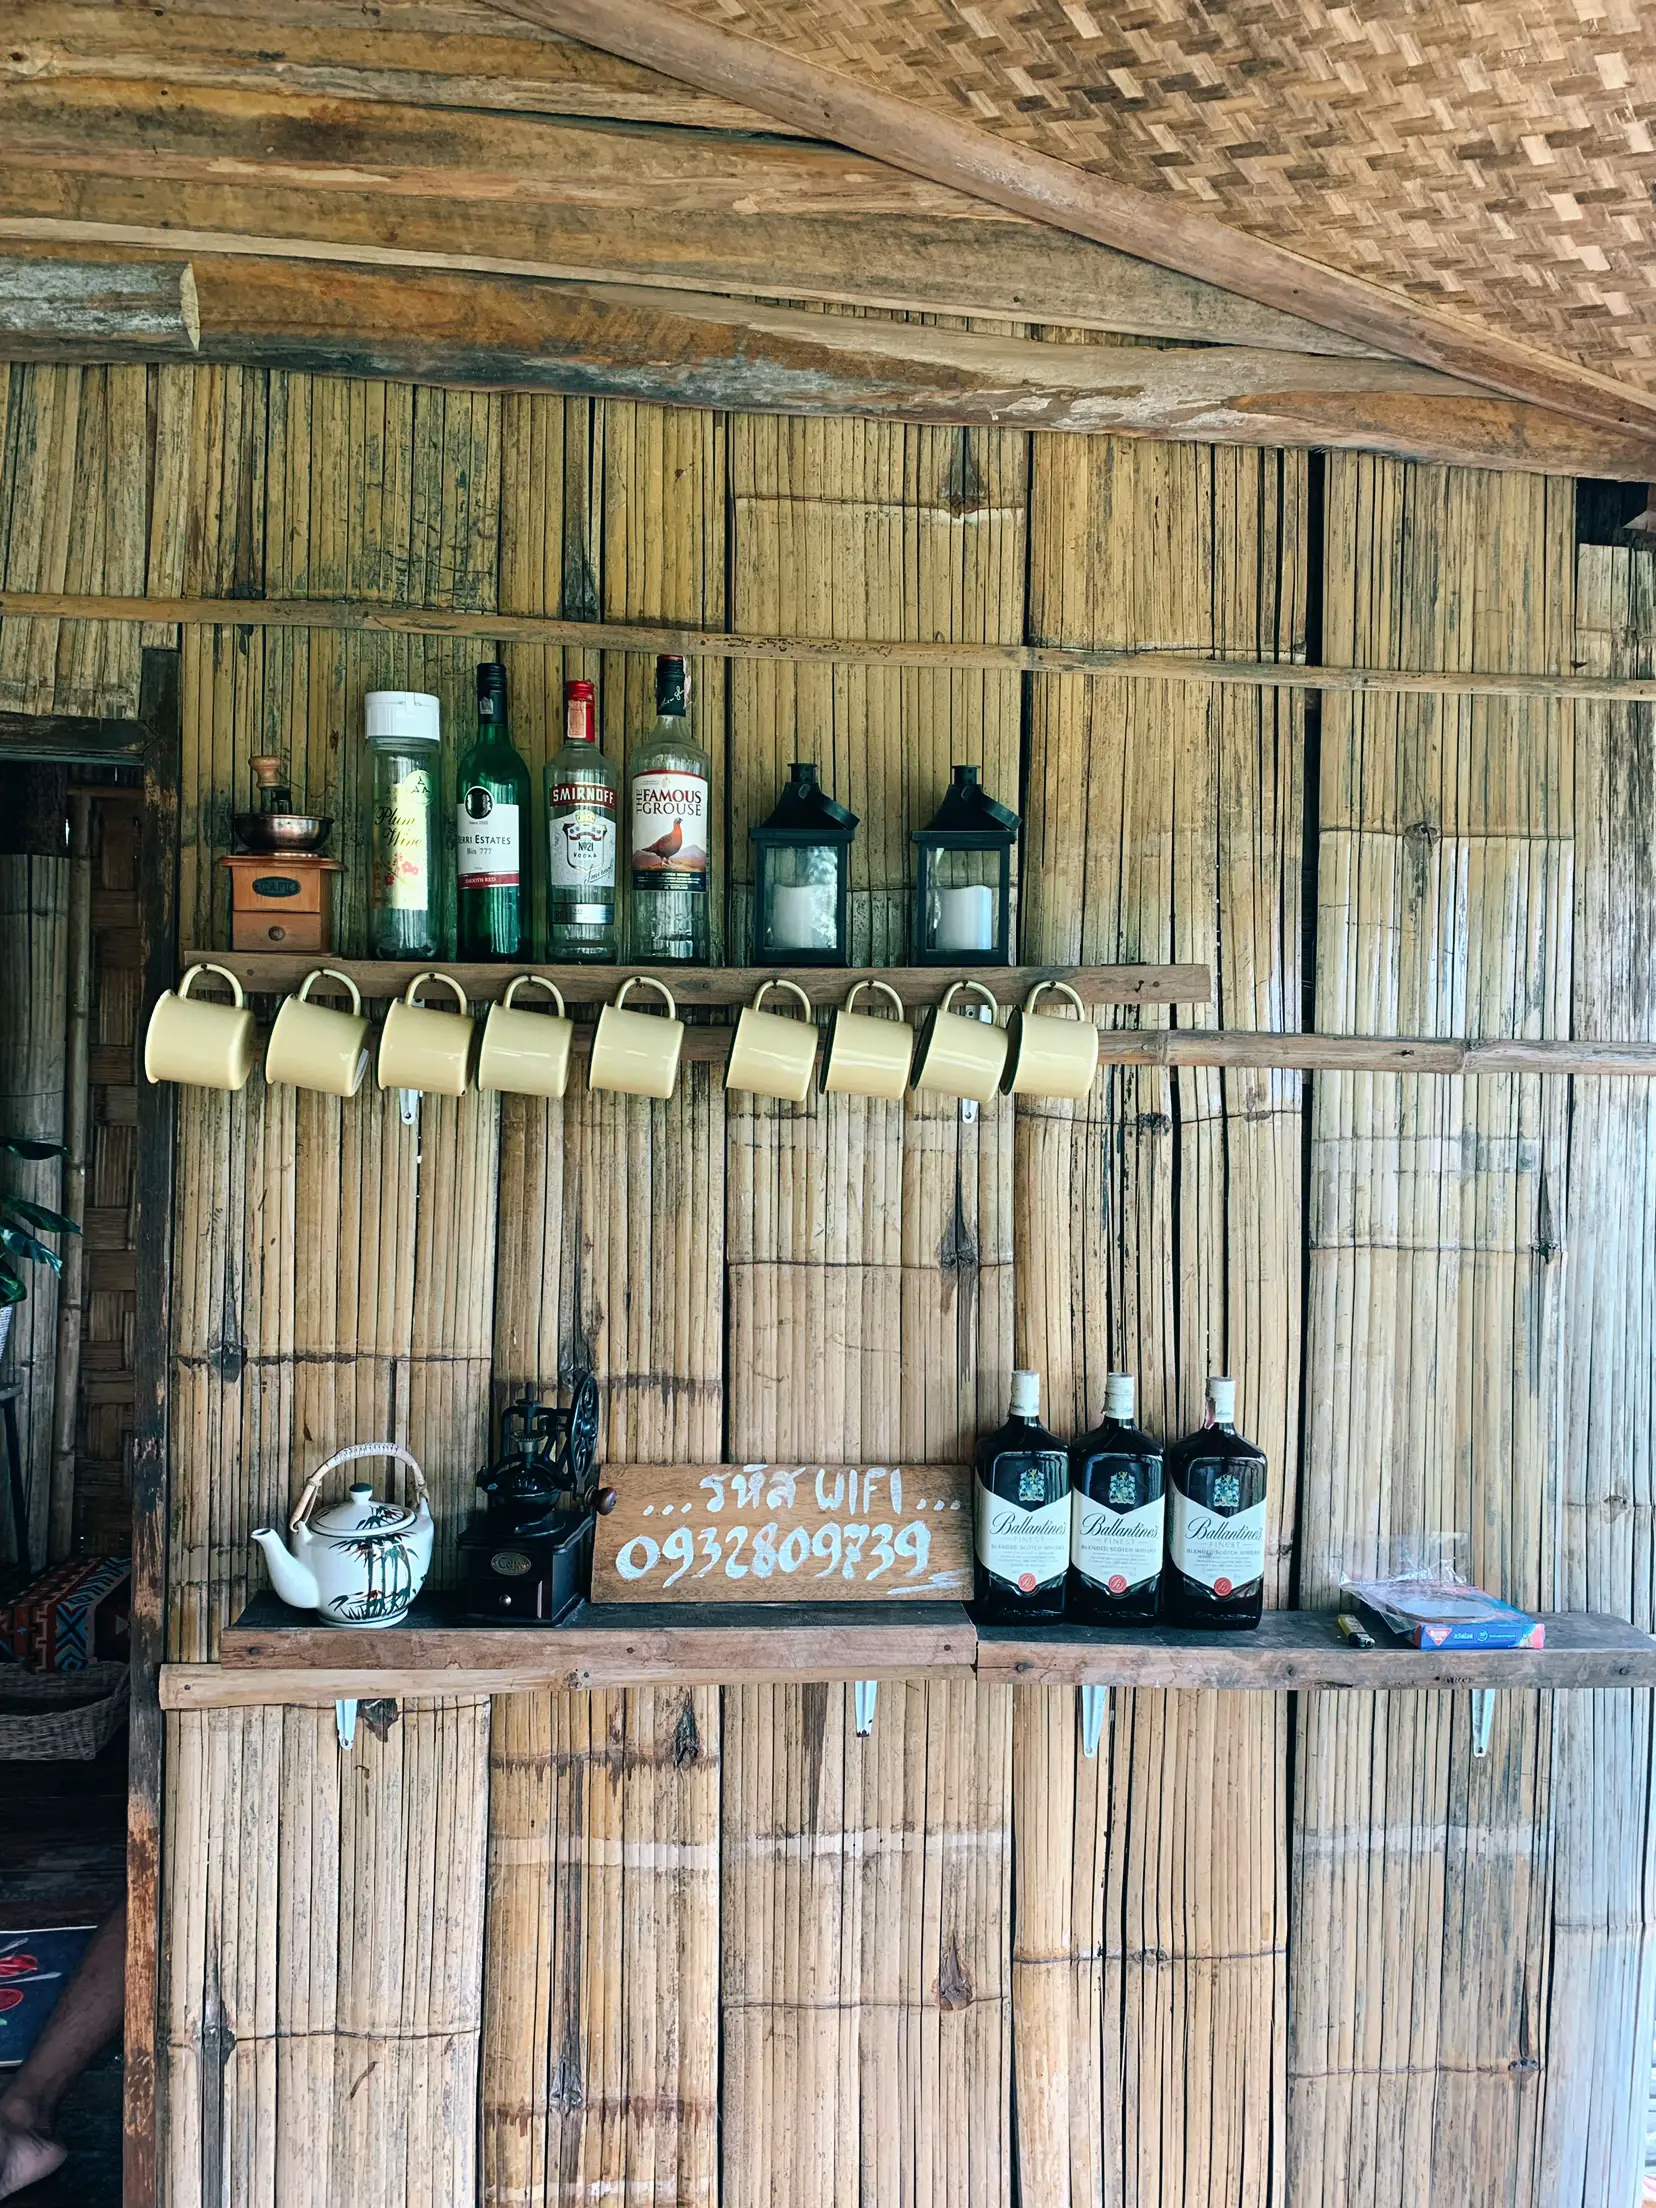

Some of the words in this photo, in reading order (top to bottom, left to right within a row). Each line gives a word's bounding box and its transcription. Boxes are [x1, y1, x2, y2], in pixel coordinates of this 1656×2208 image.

[553, 787, 614, 804] SMIRNOFF
[643, 789, 702, 804] FAMOUS
[374, 805, 416, 826] Plum
[643, 802, 702, 817] GROUSE
[382, 827, 422, 847] Wine
[990, 1511, 1067, 1536] Ballantine's
[1080, 1512, 1159, 1538] Ballantine's
[1185, 1516, 1263, 1540] Ballantine's
[1103, 1537, 1135, 1545] FINEST
[615, 1520, 932, 1589] 0932809739
